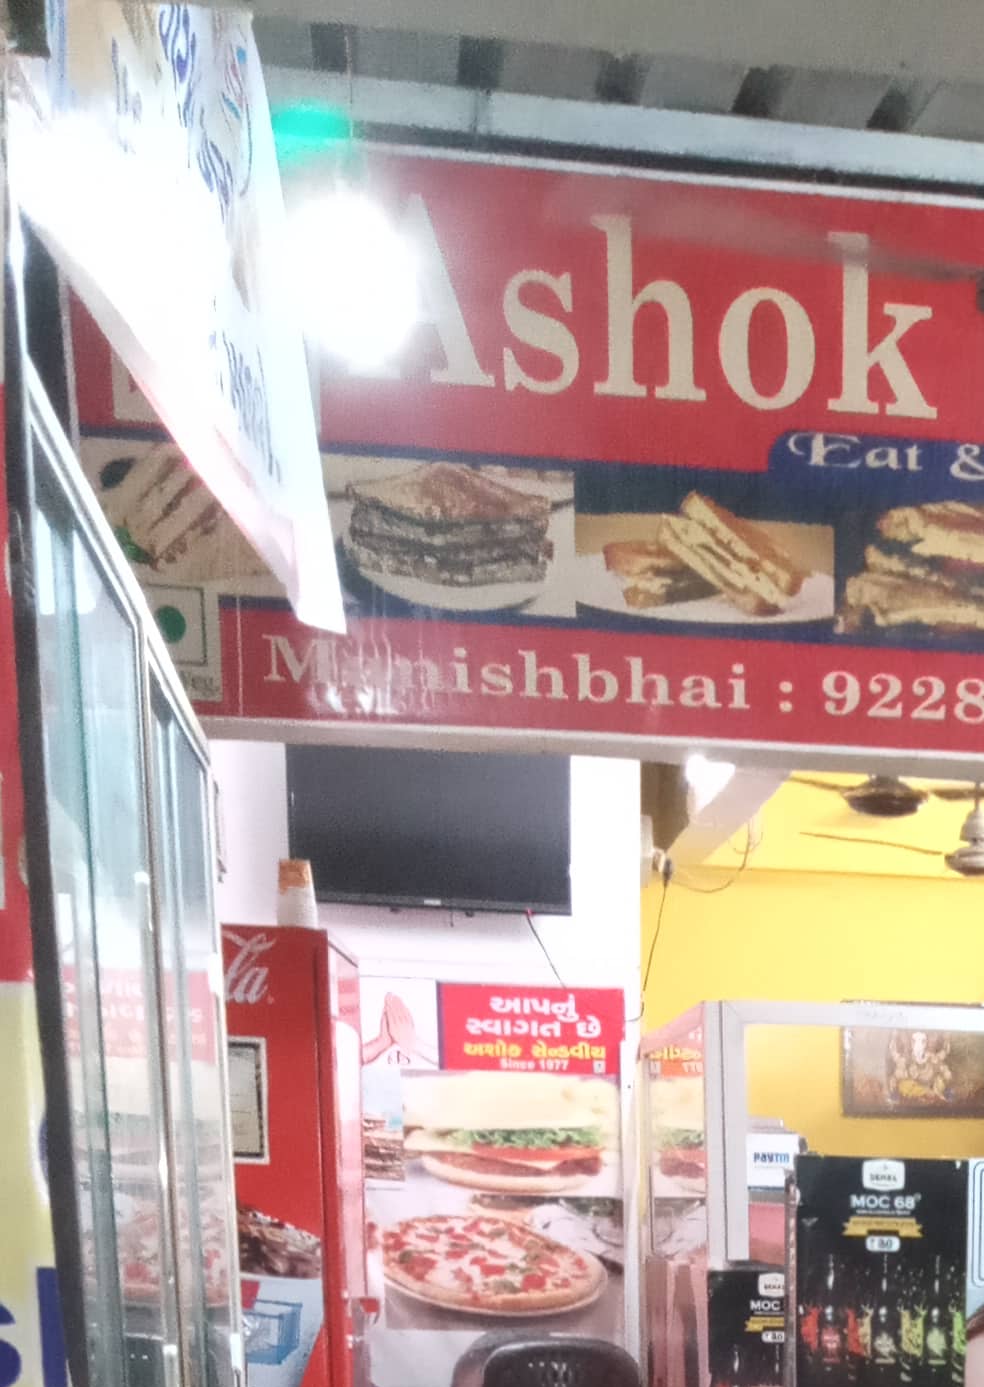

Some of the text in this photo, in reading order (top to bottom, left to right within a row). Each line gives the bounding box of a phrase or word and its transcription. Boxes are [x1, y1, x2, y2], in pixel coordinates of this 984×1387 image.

[378, 192, 938, 420] Ashok
[788, 431, 923, 471] Eat
[488, 993, 580, 1023] આપનું
[464, 1014, 602, 1038] સ્વાગત છે
[500, 1058, 570, 1071] Since 1977
[849, 1194, 890, 1210] MOC
